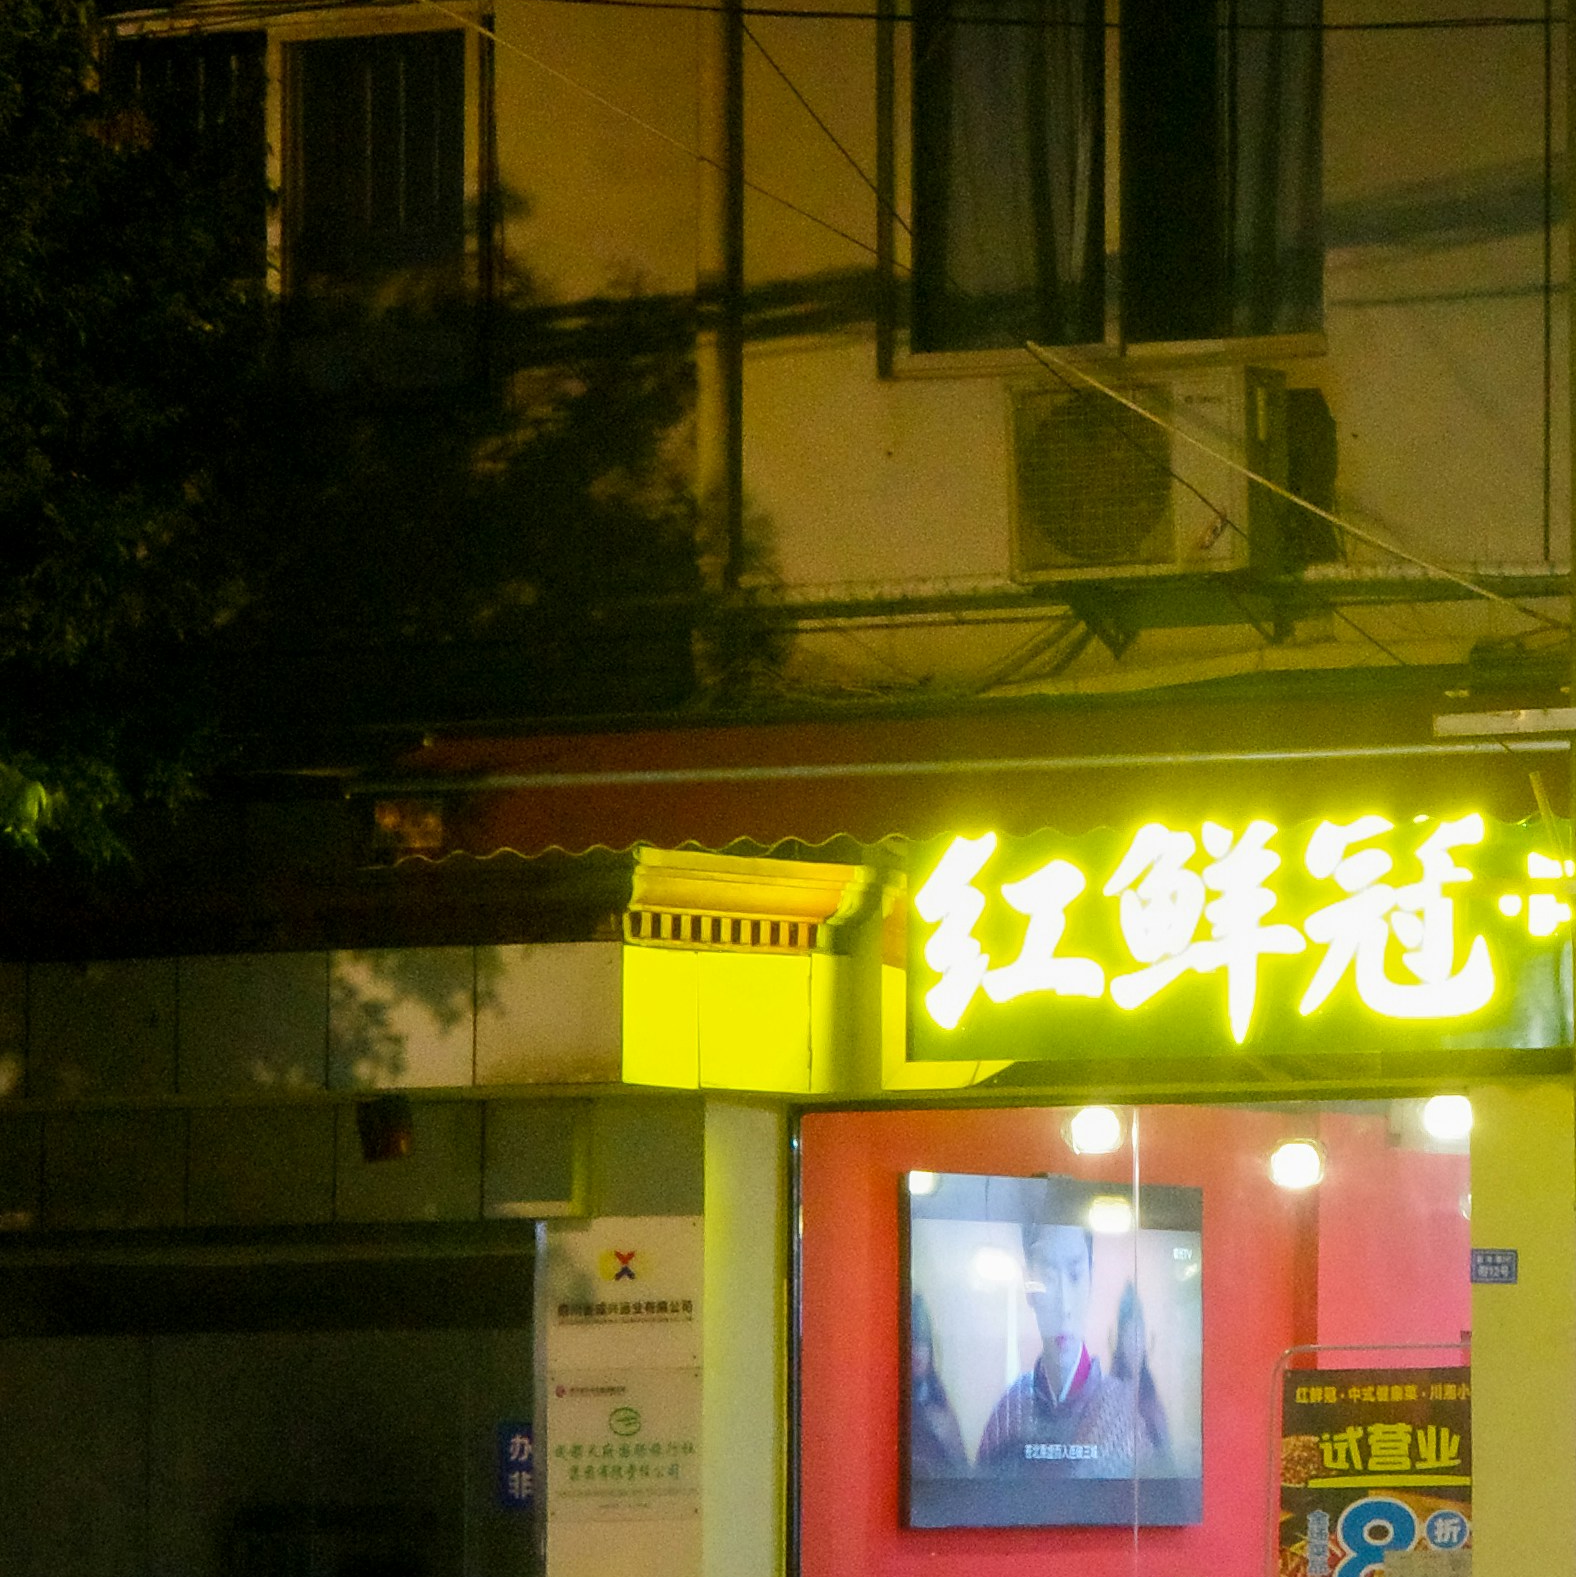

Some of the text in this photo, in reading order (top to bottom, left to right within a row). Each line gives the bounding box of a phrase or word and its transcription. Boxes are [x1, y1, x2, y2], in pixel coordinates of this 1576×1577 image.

[1319, 1423, 1462, 1471] 试营业
[1434, 1518, 1461, 1543] 折
